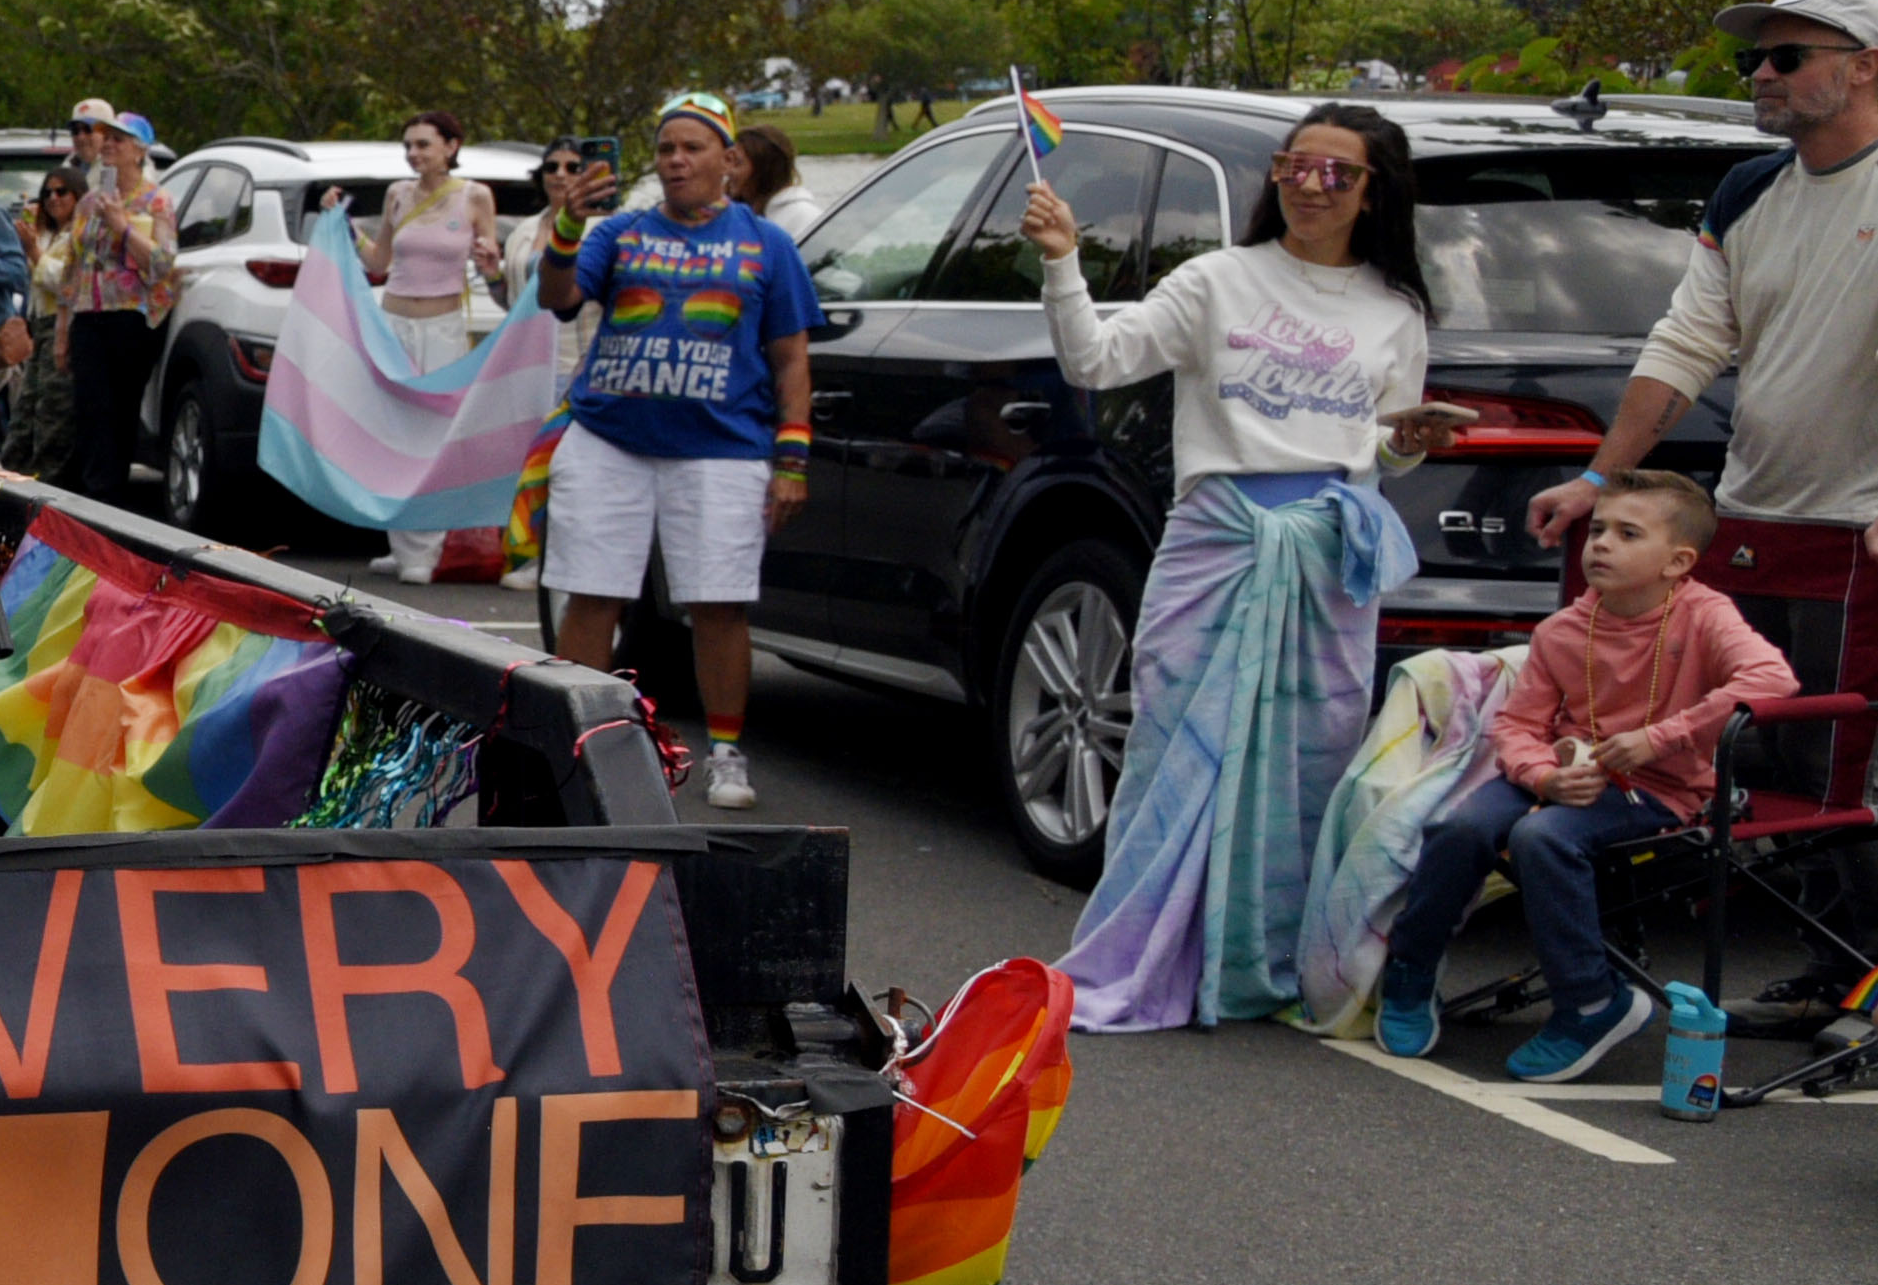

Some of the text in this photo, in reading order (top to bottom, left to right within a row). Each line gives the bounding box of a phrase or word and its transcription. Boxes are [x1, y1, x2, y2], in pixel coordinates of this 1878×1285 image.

[641, 233, 734, 259] YES, I'M
[1228, 300, 1355, 358] Love
[643, 336, 670, 359] IS
[676, 338, 733, 367] YOUR
[588, 358, 730, 402] CHANCE
[1439, 510, 1505, 533] Q5
[711, 1160, 788, 1284] U
